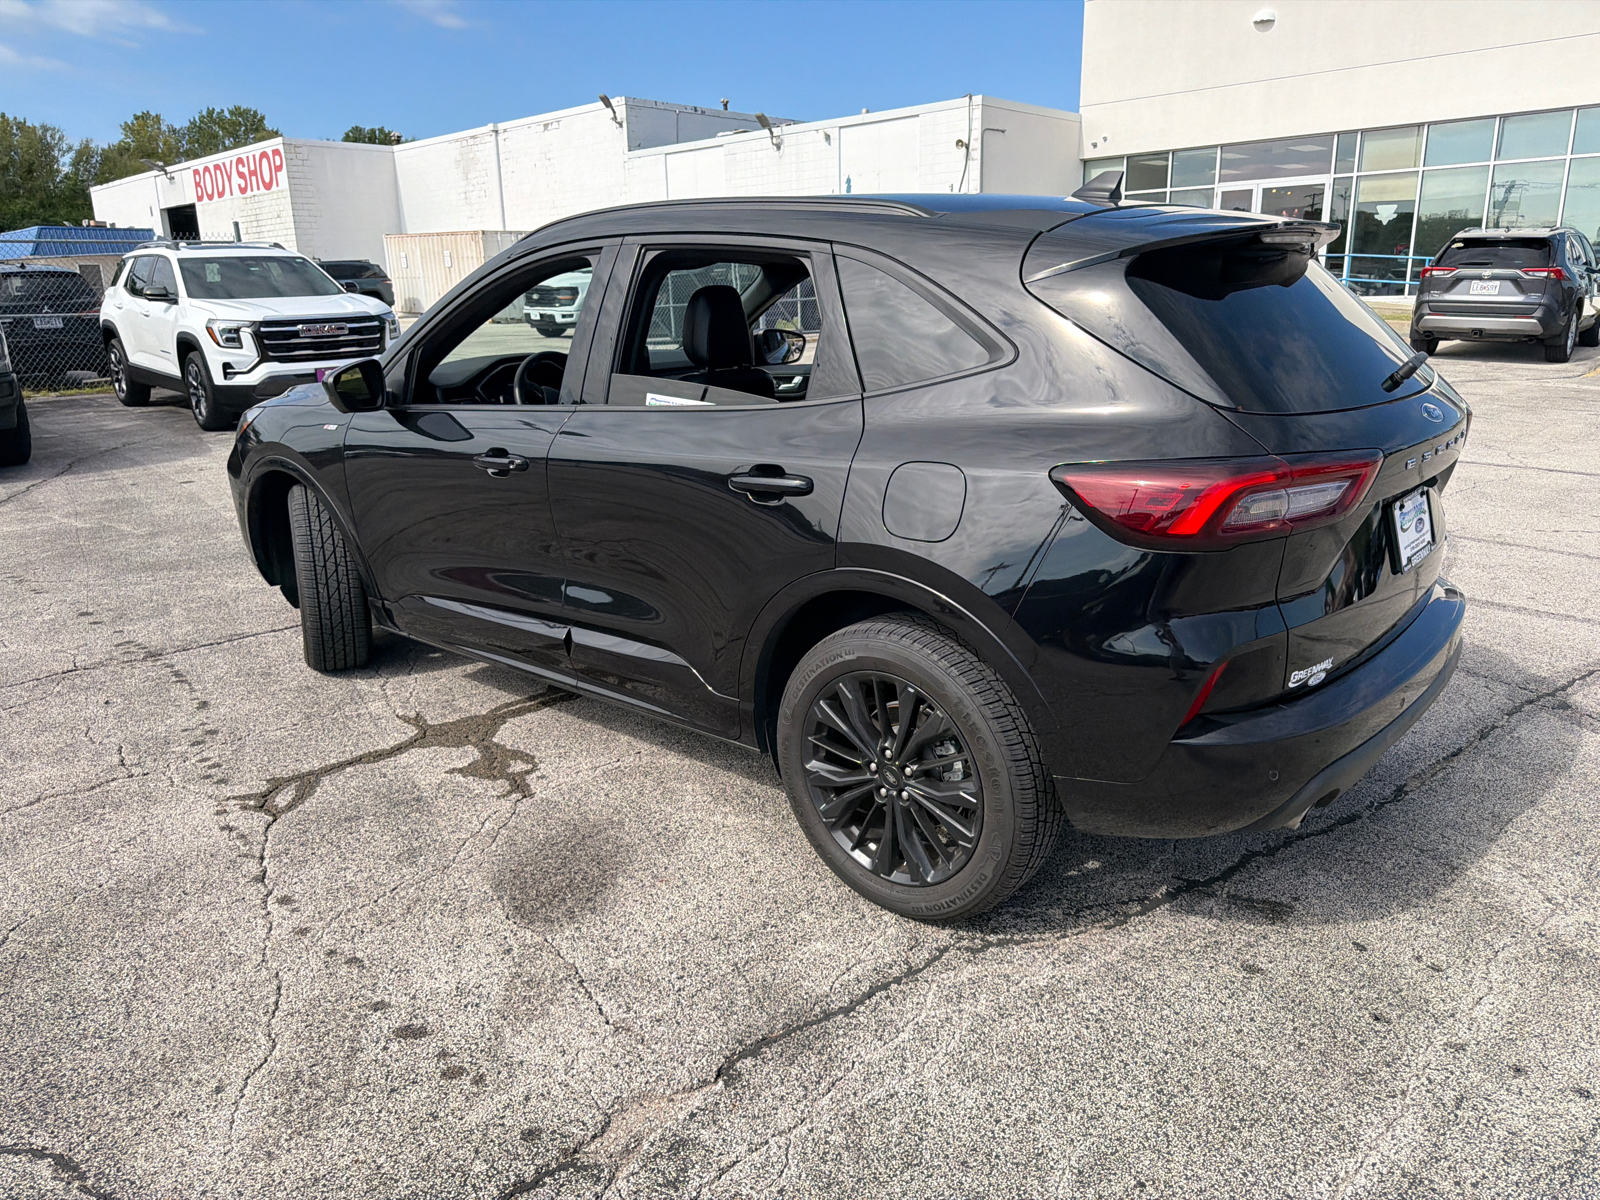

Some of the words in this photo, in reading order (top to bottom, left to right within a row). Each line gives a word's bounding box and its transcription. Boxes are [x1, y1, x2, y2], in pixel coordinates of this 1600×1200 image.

[193, 160, 233, 202] BODY
[235, 148, 283, 195] SHOP
[791, 651, 843, 699] DESTINATION
[1290, 656, 1334, 682] GREENWAY
[952, 698, 1003, 825] Firestone
[924, 873, 988, 913] DESTINATION
